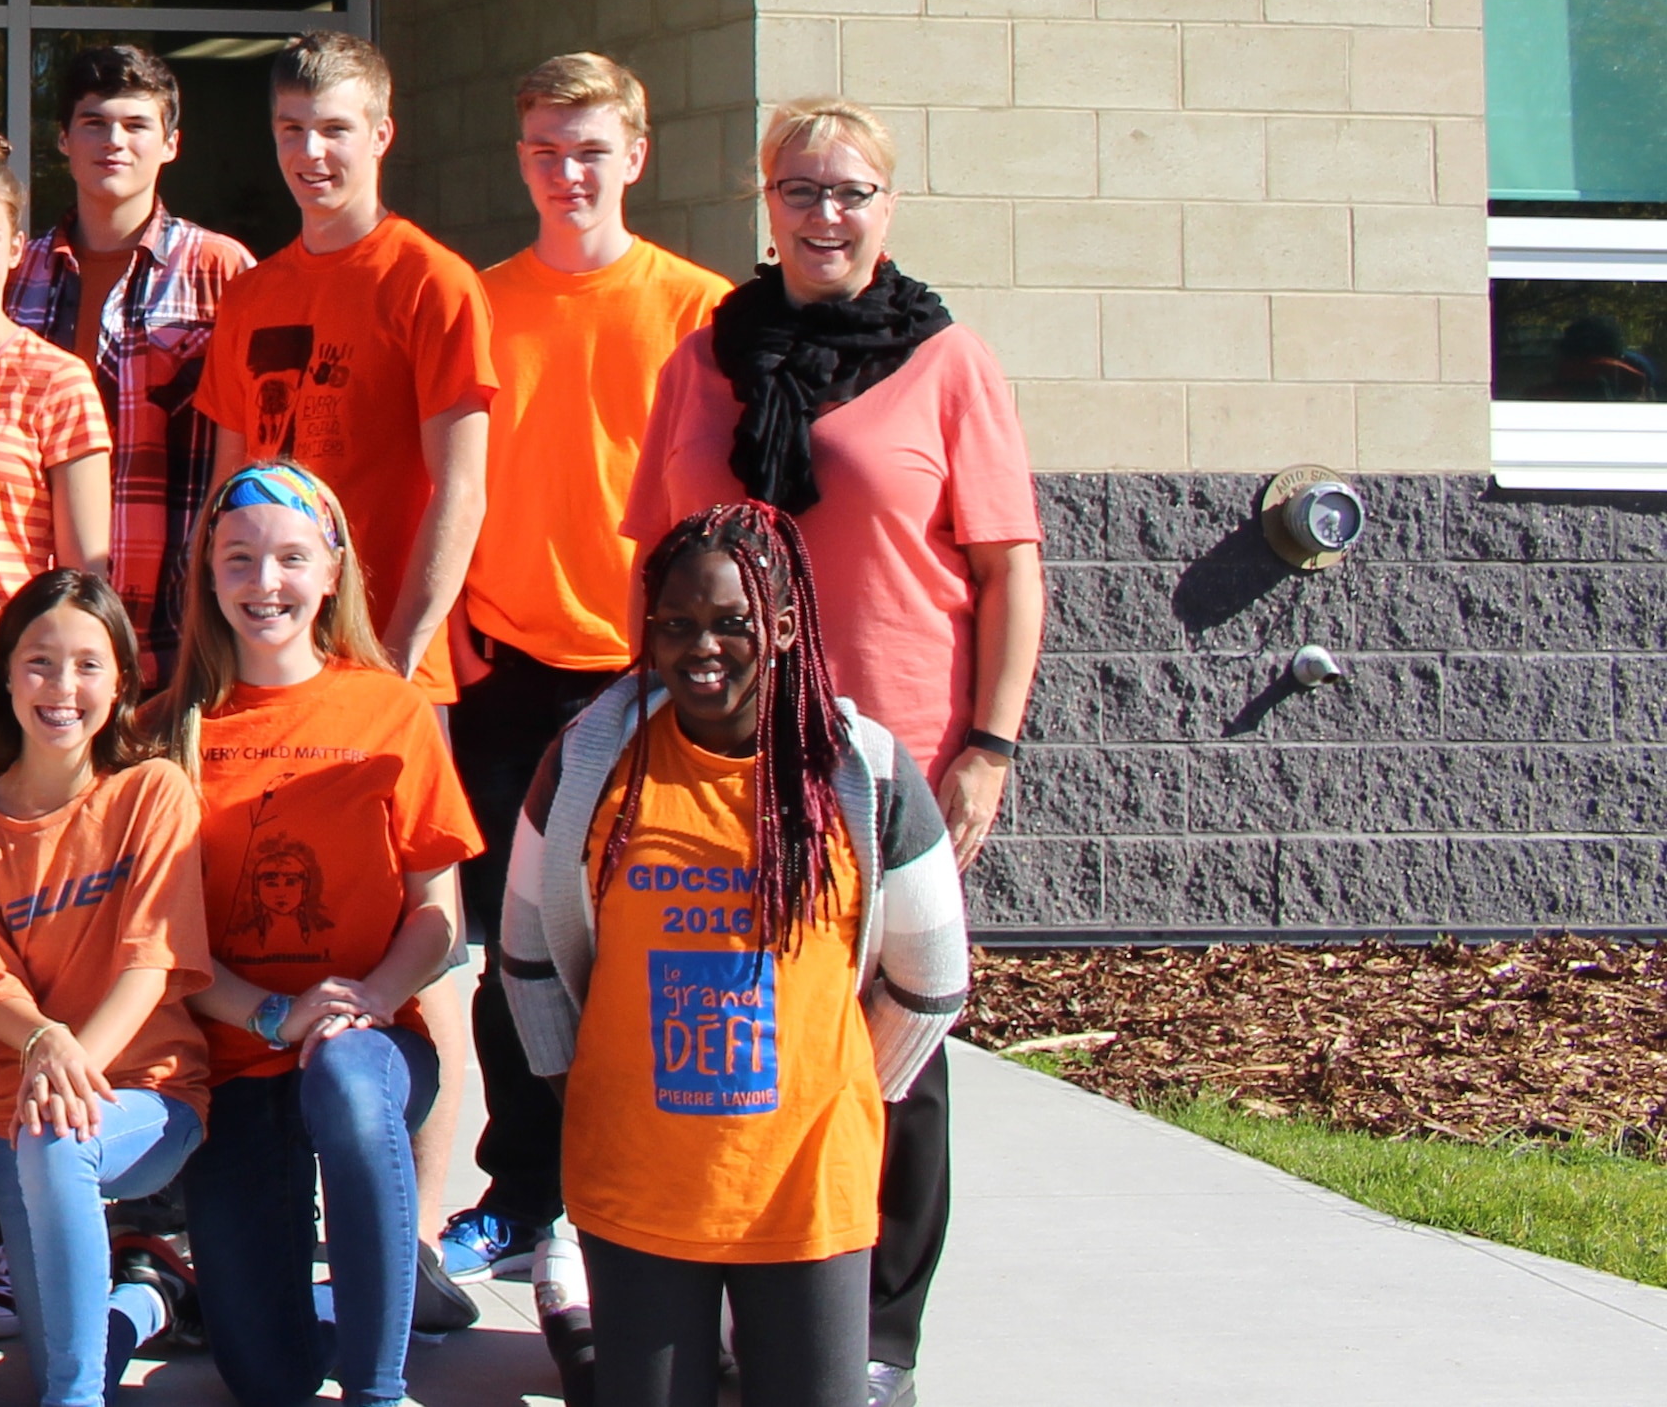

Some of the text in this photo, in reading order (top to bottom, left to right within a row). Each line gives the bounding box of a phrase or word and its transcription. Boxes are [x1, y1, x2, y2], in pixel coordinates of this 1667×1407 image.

[201, 745, 370, 762] VERY CHILD MATTERS
[663, 906, 754, 934] 2016
[663, 983, 764, 1017] grand
[658, 1088, 777, 1107] PIERRE LAVOIE
